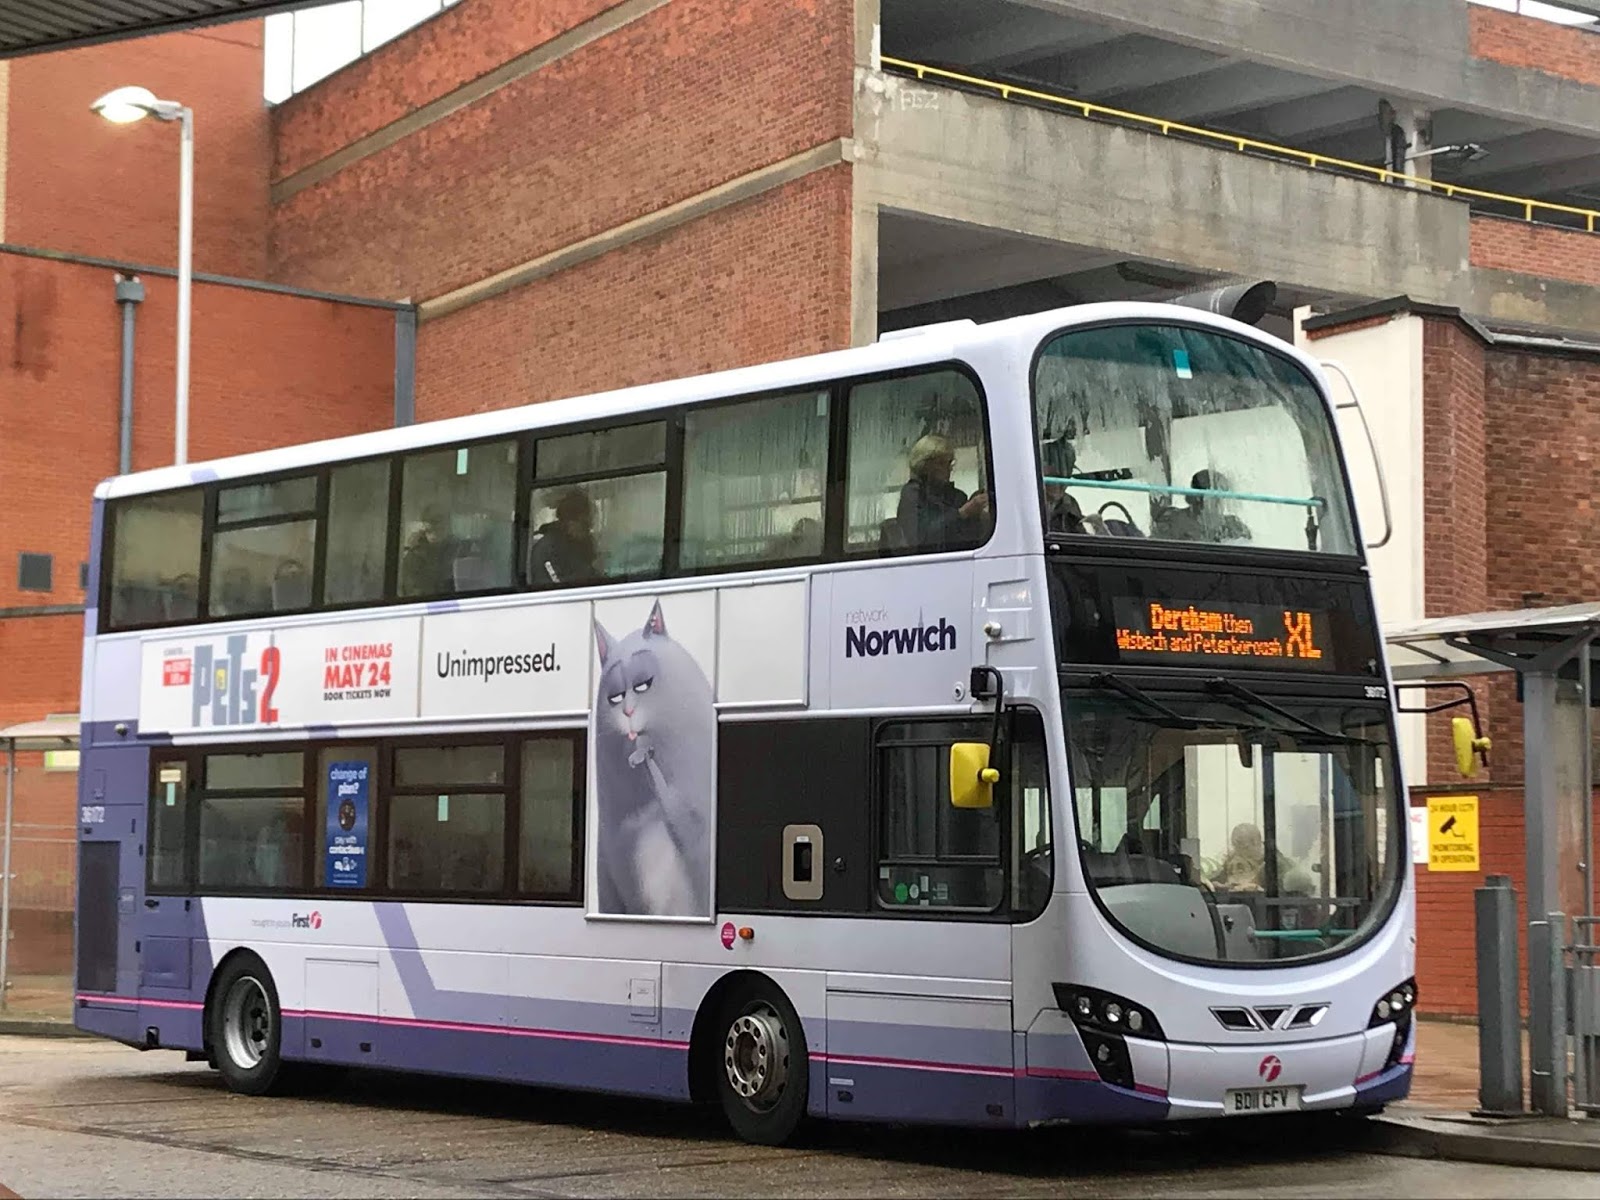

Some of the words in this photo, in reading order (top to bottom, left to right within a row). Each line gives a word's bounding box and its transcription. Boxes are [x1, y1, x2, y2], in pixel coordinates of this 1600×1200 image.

[846, 606, 888, 624] network
[1150, 603, 1224, 633] Dereham
[1224, 614, 1254, 634] then
[846, 617, 956, 658] Norwich
[1116, 629, 1168, 651] Wisbech
[1169, 635, 1193, 653] and
[1284, 611, 1322, 658] XL
[325, 648, 338, 662] IN
[342, 643, 393, 662] CINEMAS
[437, 643, 560, 683] Unimpressed.
[260, 645, 281, 724] 2
[324, 664, 365, 690] MAY
[368, 661, 391, 686] 24
[324, 692, 344, 701] BOOK
[346, 690, 372, 700] TICKETS
[374, 688, 391, 698] NOW
[330, 768, 358, 782] change
[358, 766, 368, 780] of
[338, 782, 360, 797] plan?
[1440, 804, 1457, 813] HOUR
[1459, 803, 1475, 812] CCTV
[1432, 843, 1474, 852] MONITORING
[1432, 854, 1438, 863] IN
[1441, 854, 1475, 863] OPERATION
[292, 912, 310, 929] First
[1234, 1092, 1259, 1111] BD11
[1262, 1089, 1289, 1109] CFV
